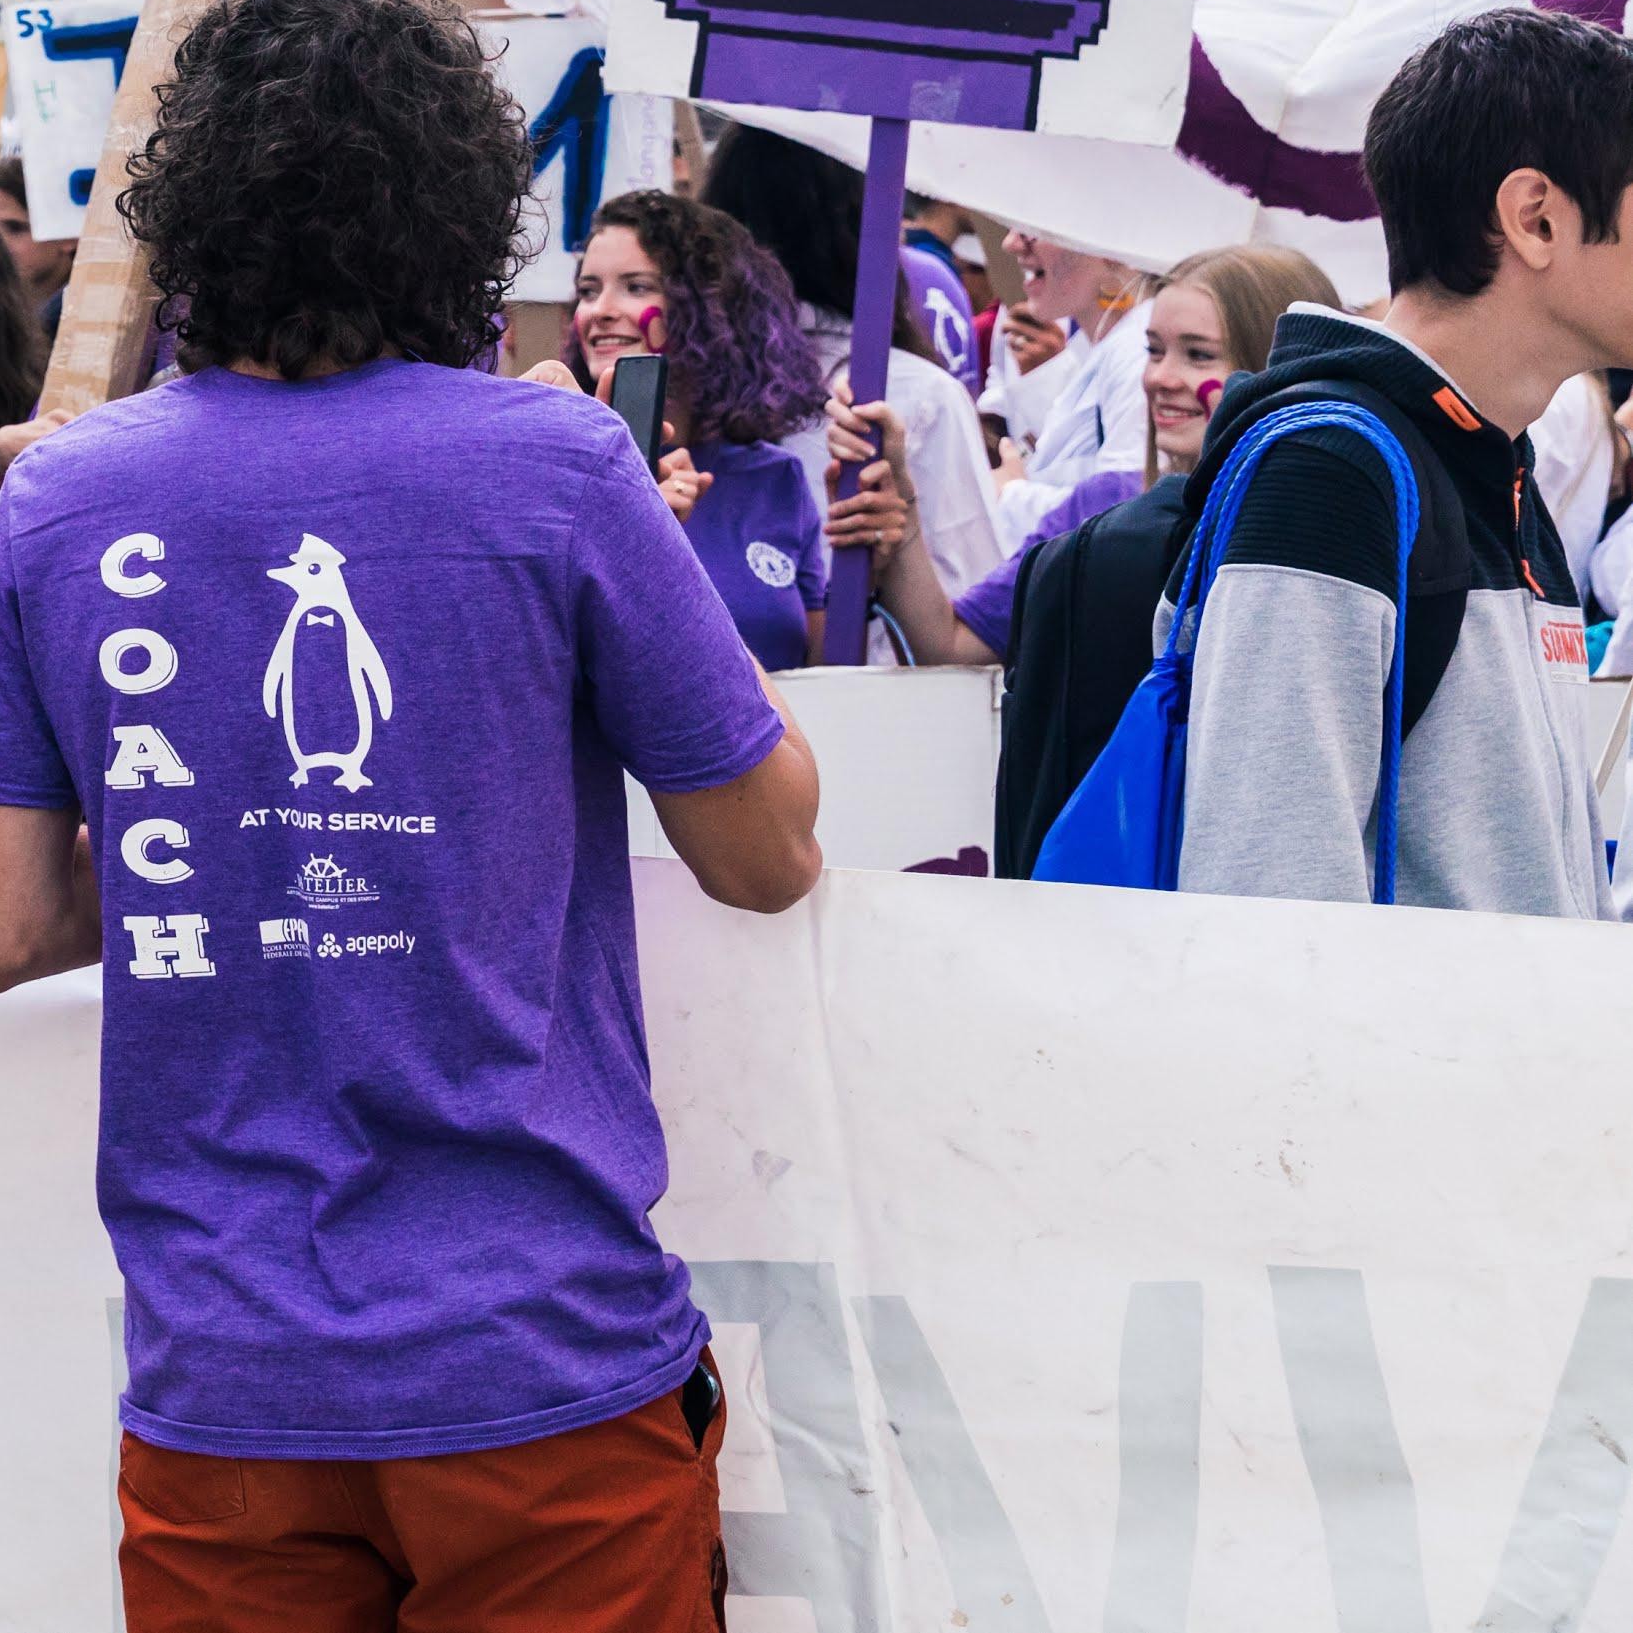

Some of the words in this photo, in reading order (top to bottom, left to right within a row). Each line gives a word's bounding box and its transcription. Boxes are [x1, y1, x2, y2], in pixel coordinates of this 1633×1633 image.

[15, 8, 55, 39] 53
[98, 532, 217, 980] COACH
[239, 808, 271, 829] AT
[275, 808, 323, 831] YOUR
[328, 813, 436, 834] SERVICE
[346, 930, 416, 956] agepoly
